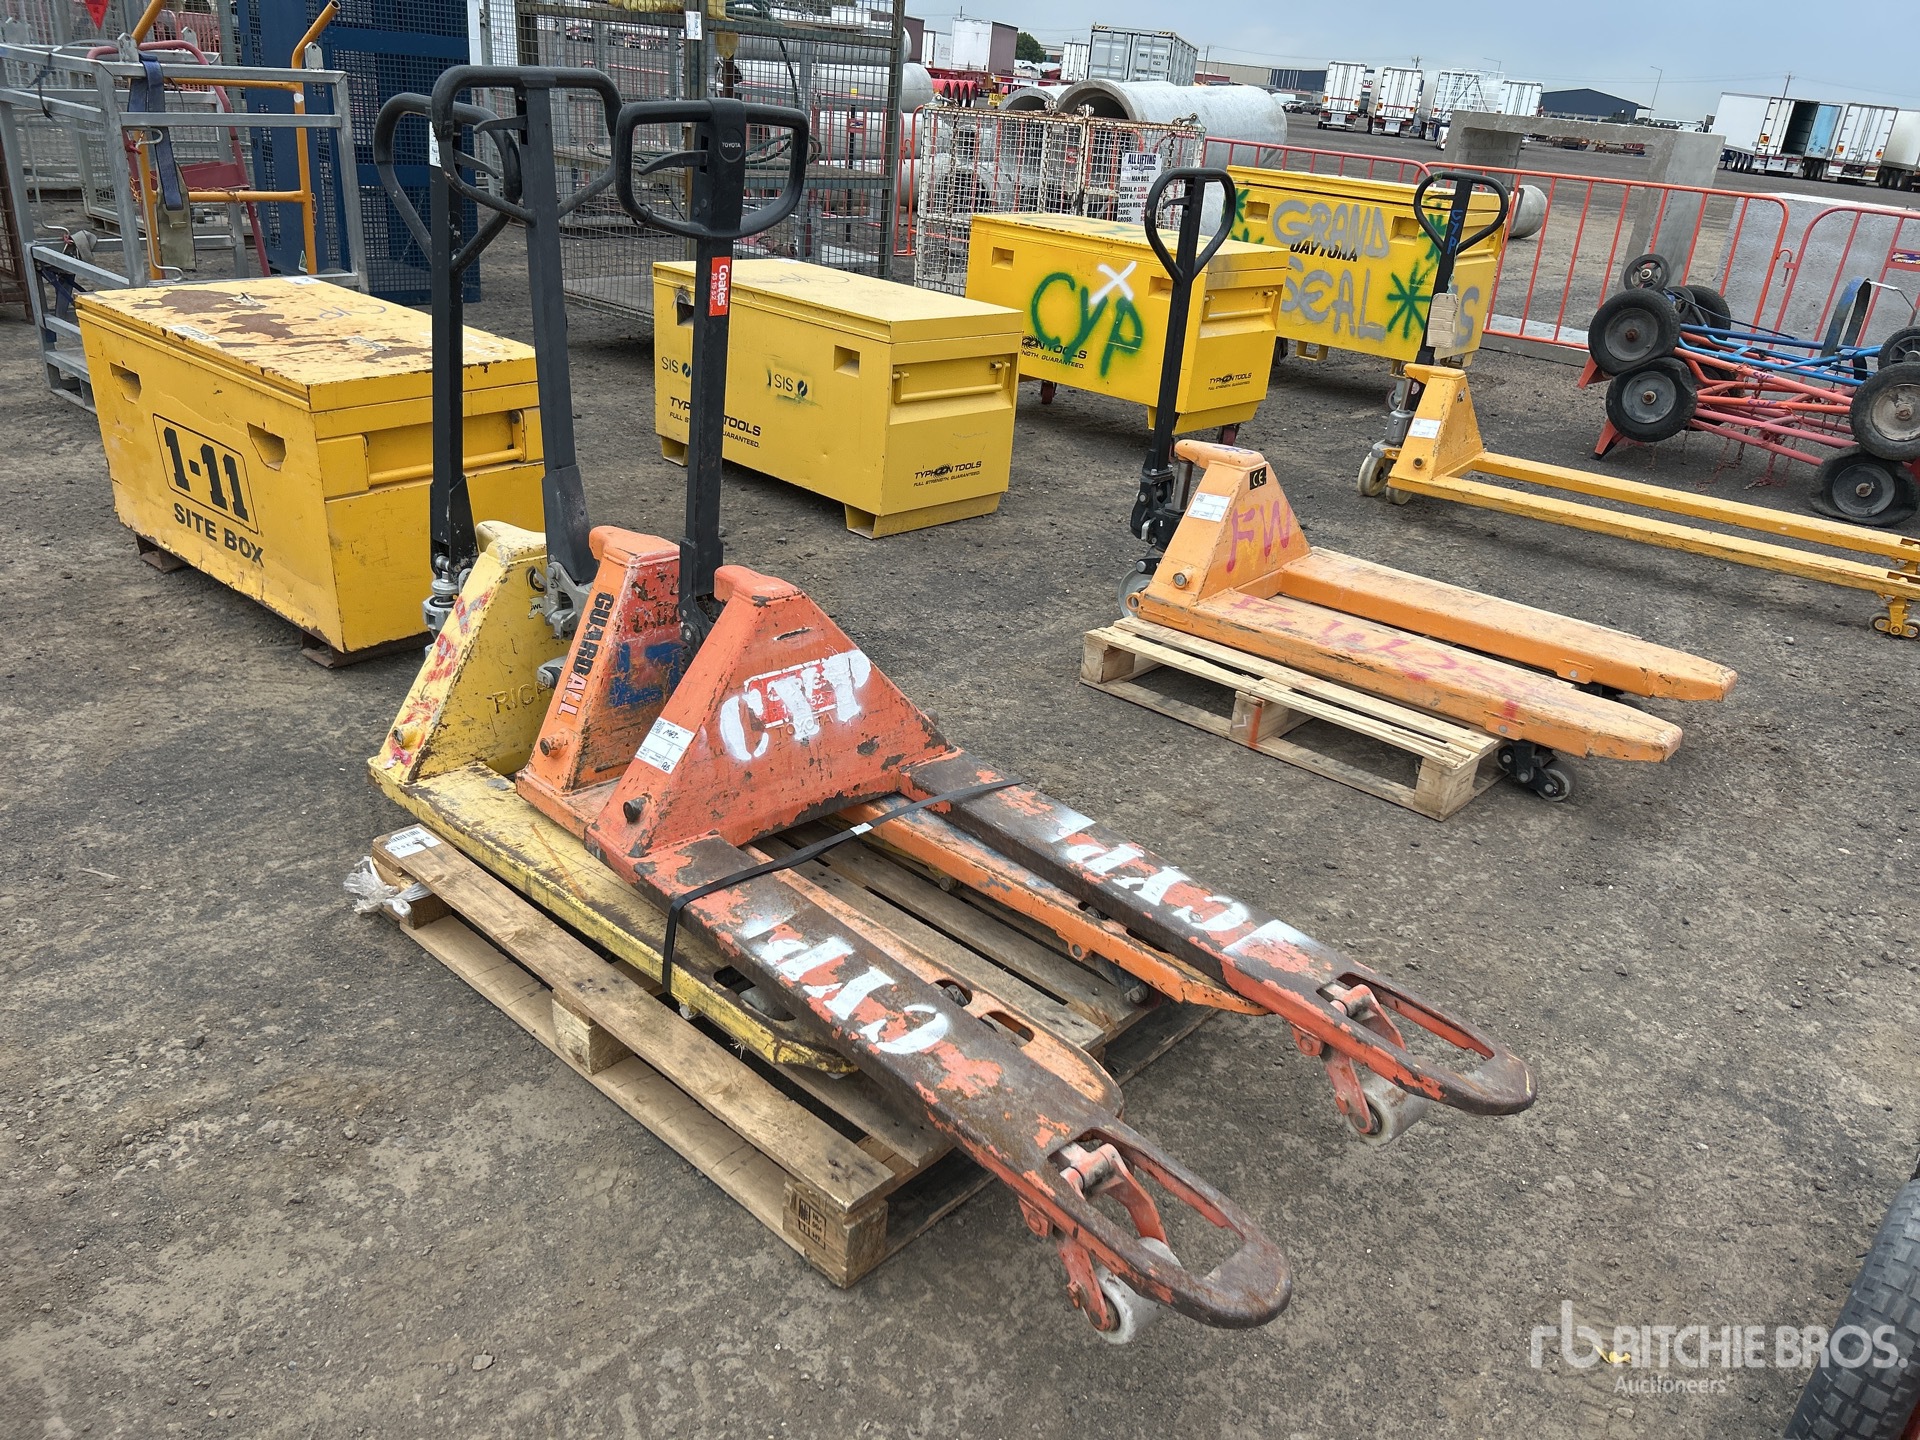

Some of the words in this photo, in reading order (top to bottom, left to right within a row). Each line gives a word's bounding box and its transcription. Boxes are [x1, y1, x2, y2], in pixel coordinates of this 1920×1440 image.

[1128, 154, 1136, 165] ALL
[1137, 154, 1156, 165] LIFTING
[1272, 200, 1390, 259] GRAND
[1290, 240, 1358, 262] DAYTONA
[717, 264, 729, 306] Coates
[1031, 272, 1144, 378] CYP
[661, 356, 679, 373] SIS
[774, 373, 794, 392] SIS
[669, 411, 683, 421] FULL
[723, 431, 760, 448] UARANTEED.
[724, 414, 761, 437] TOOLS
[163, 426, 250, 522] 1-11
[914, 464, 954, 479] TYPHOON
[955, 460, 982, 471] TOOLS
[1252, 470, 1264, 486] CE
[173, 502, 218, 542] SITE
[223, 527, 265, 568] BOX
[1226, 500, 1292, 573] FW
[720, 649, 871, 761] CYP
